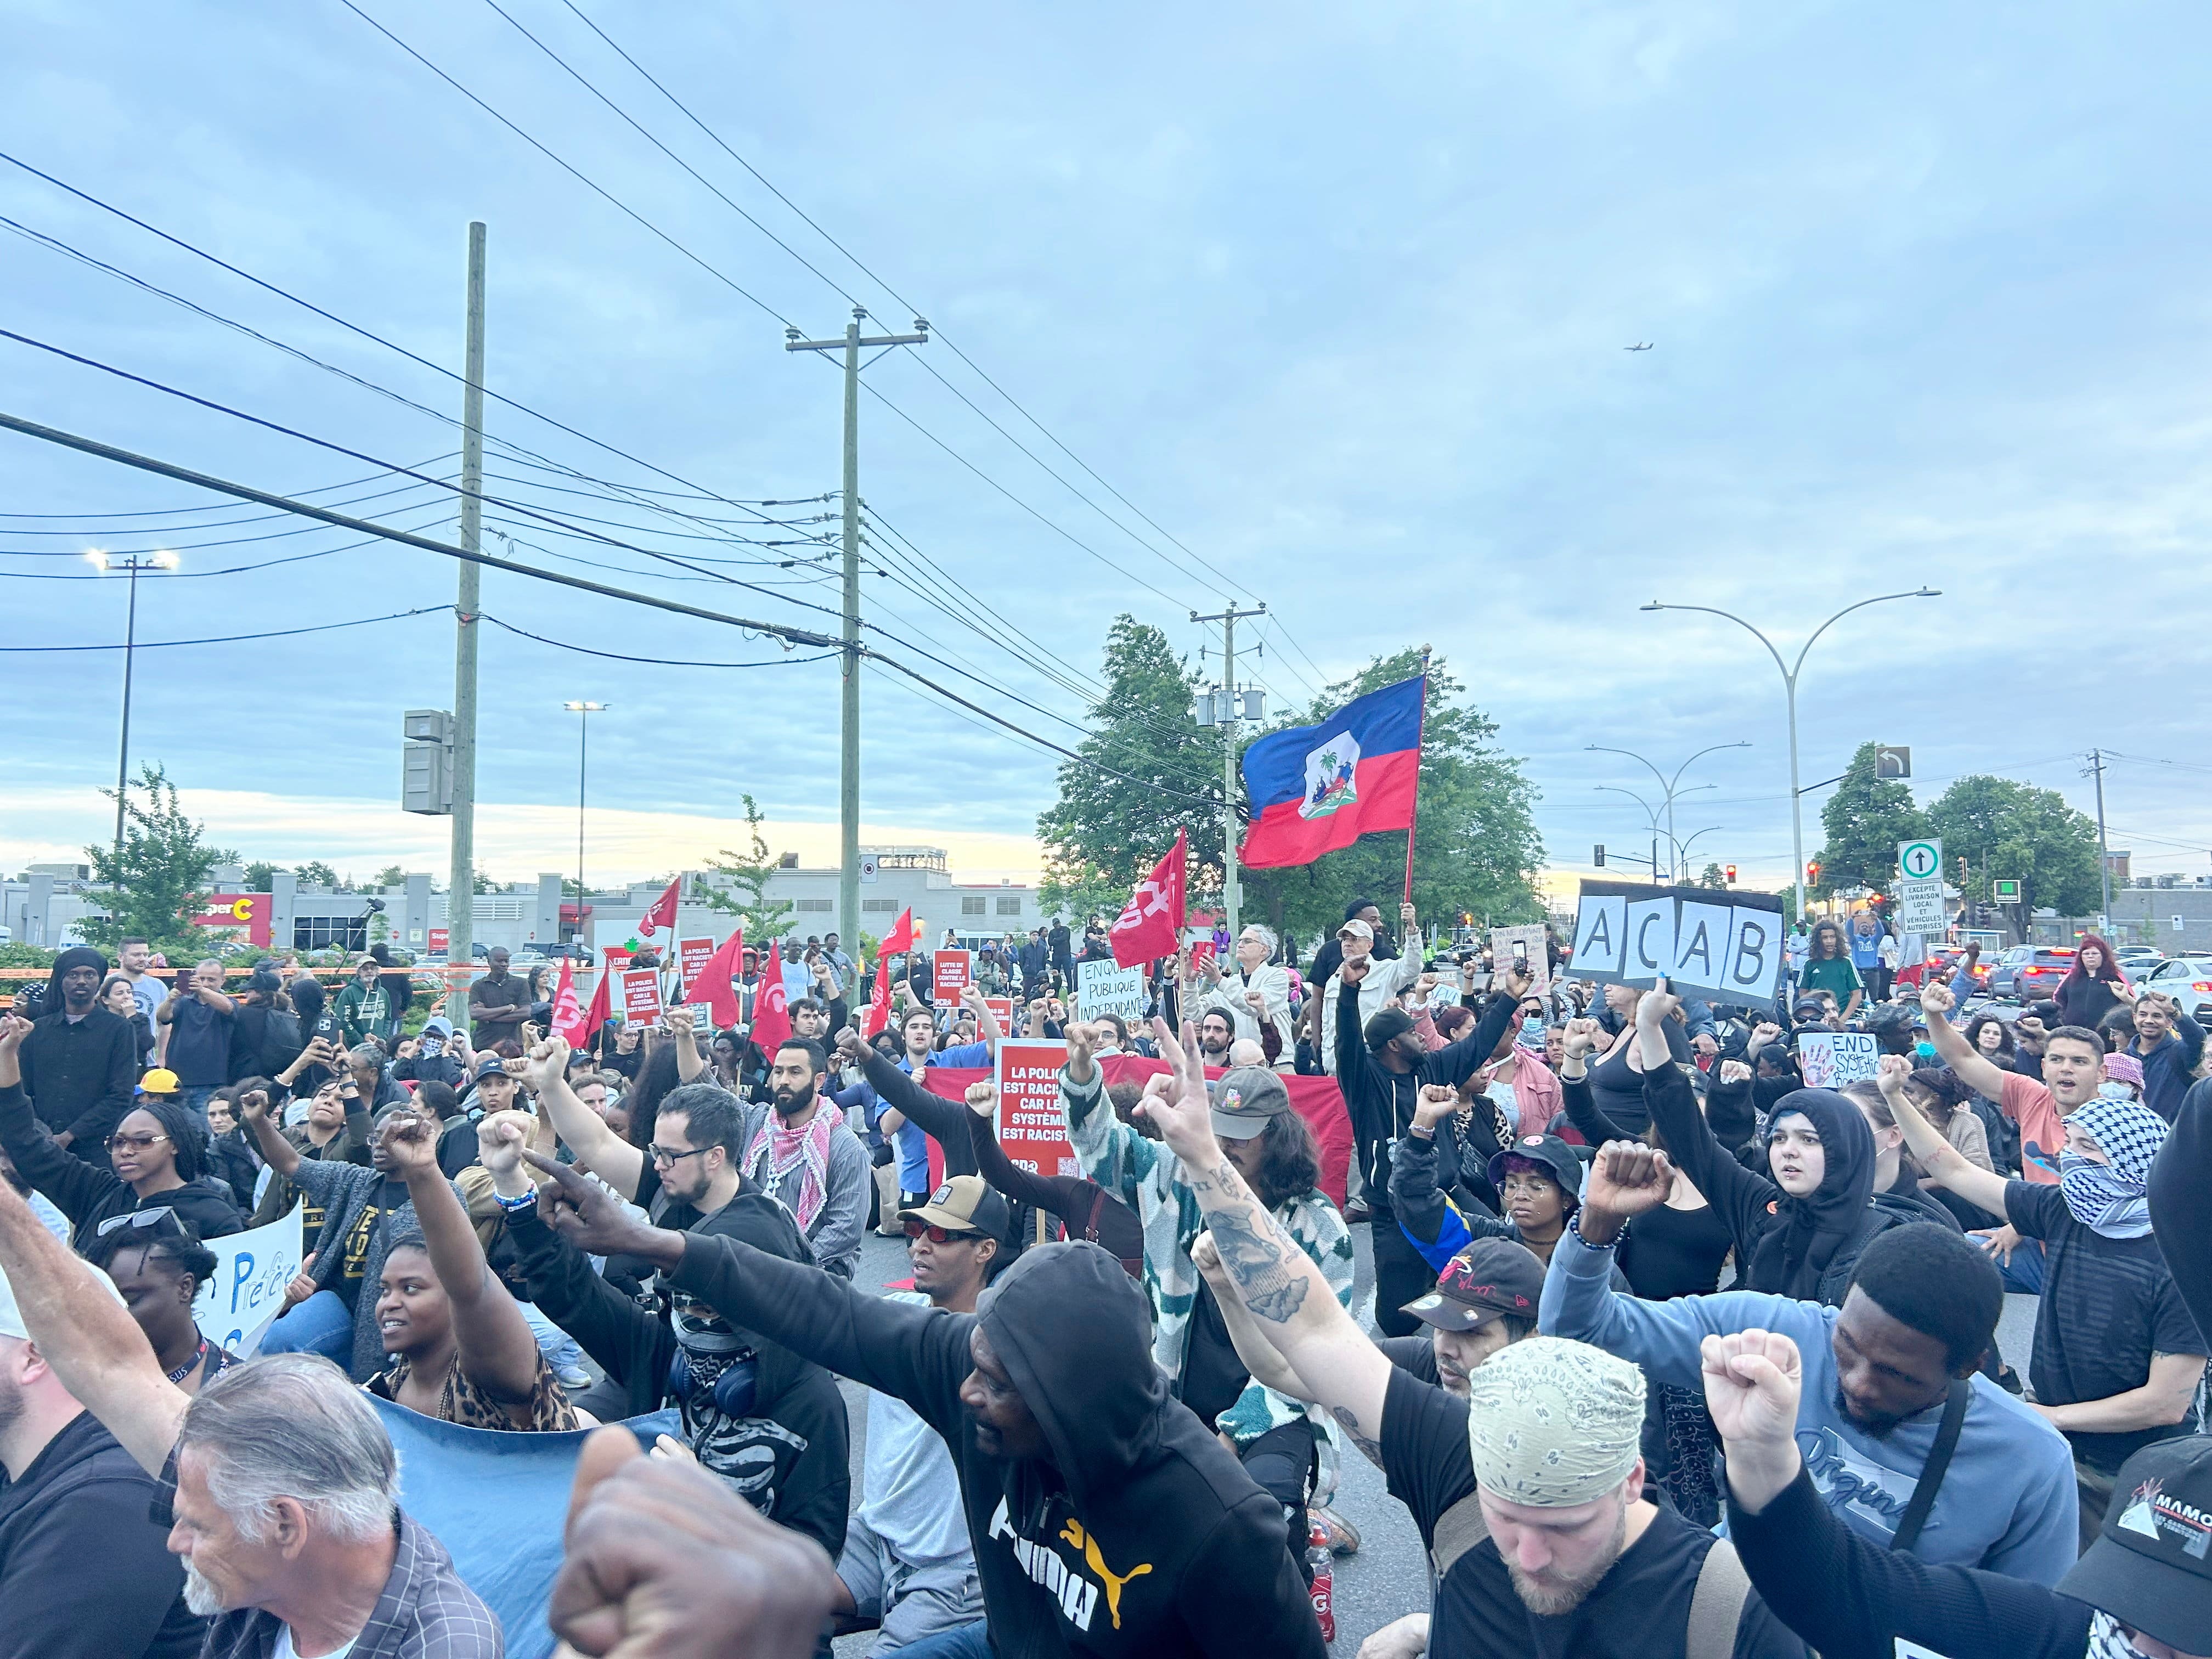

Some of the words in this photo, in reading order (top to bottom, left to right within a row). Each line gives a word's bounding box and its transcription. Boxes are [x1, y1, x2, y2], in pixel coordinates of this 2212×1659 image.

[1905, 893, 1939, 901] LIVRAISON
[234, 899, 254, 921] C
[1906, 915, 1942, 923] VÉHICULES
[1907, 922, 1942, 931] AUTORISÉS
[1090, 980, 1136, 999] PUBLIQUE
[1832, 1036, 1873, 1052] END
[1011, 1067, 1026, 1079] LA
[1003, 1082, 1026, 1093] EST
[1020, 1098, 1045, 1110] CAR
[1002, 1128, 1025, 1139] EST
